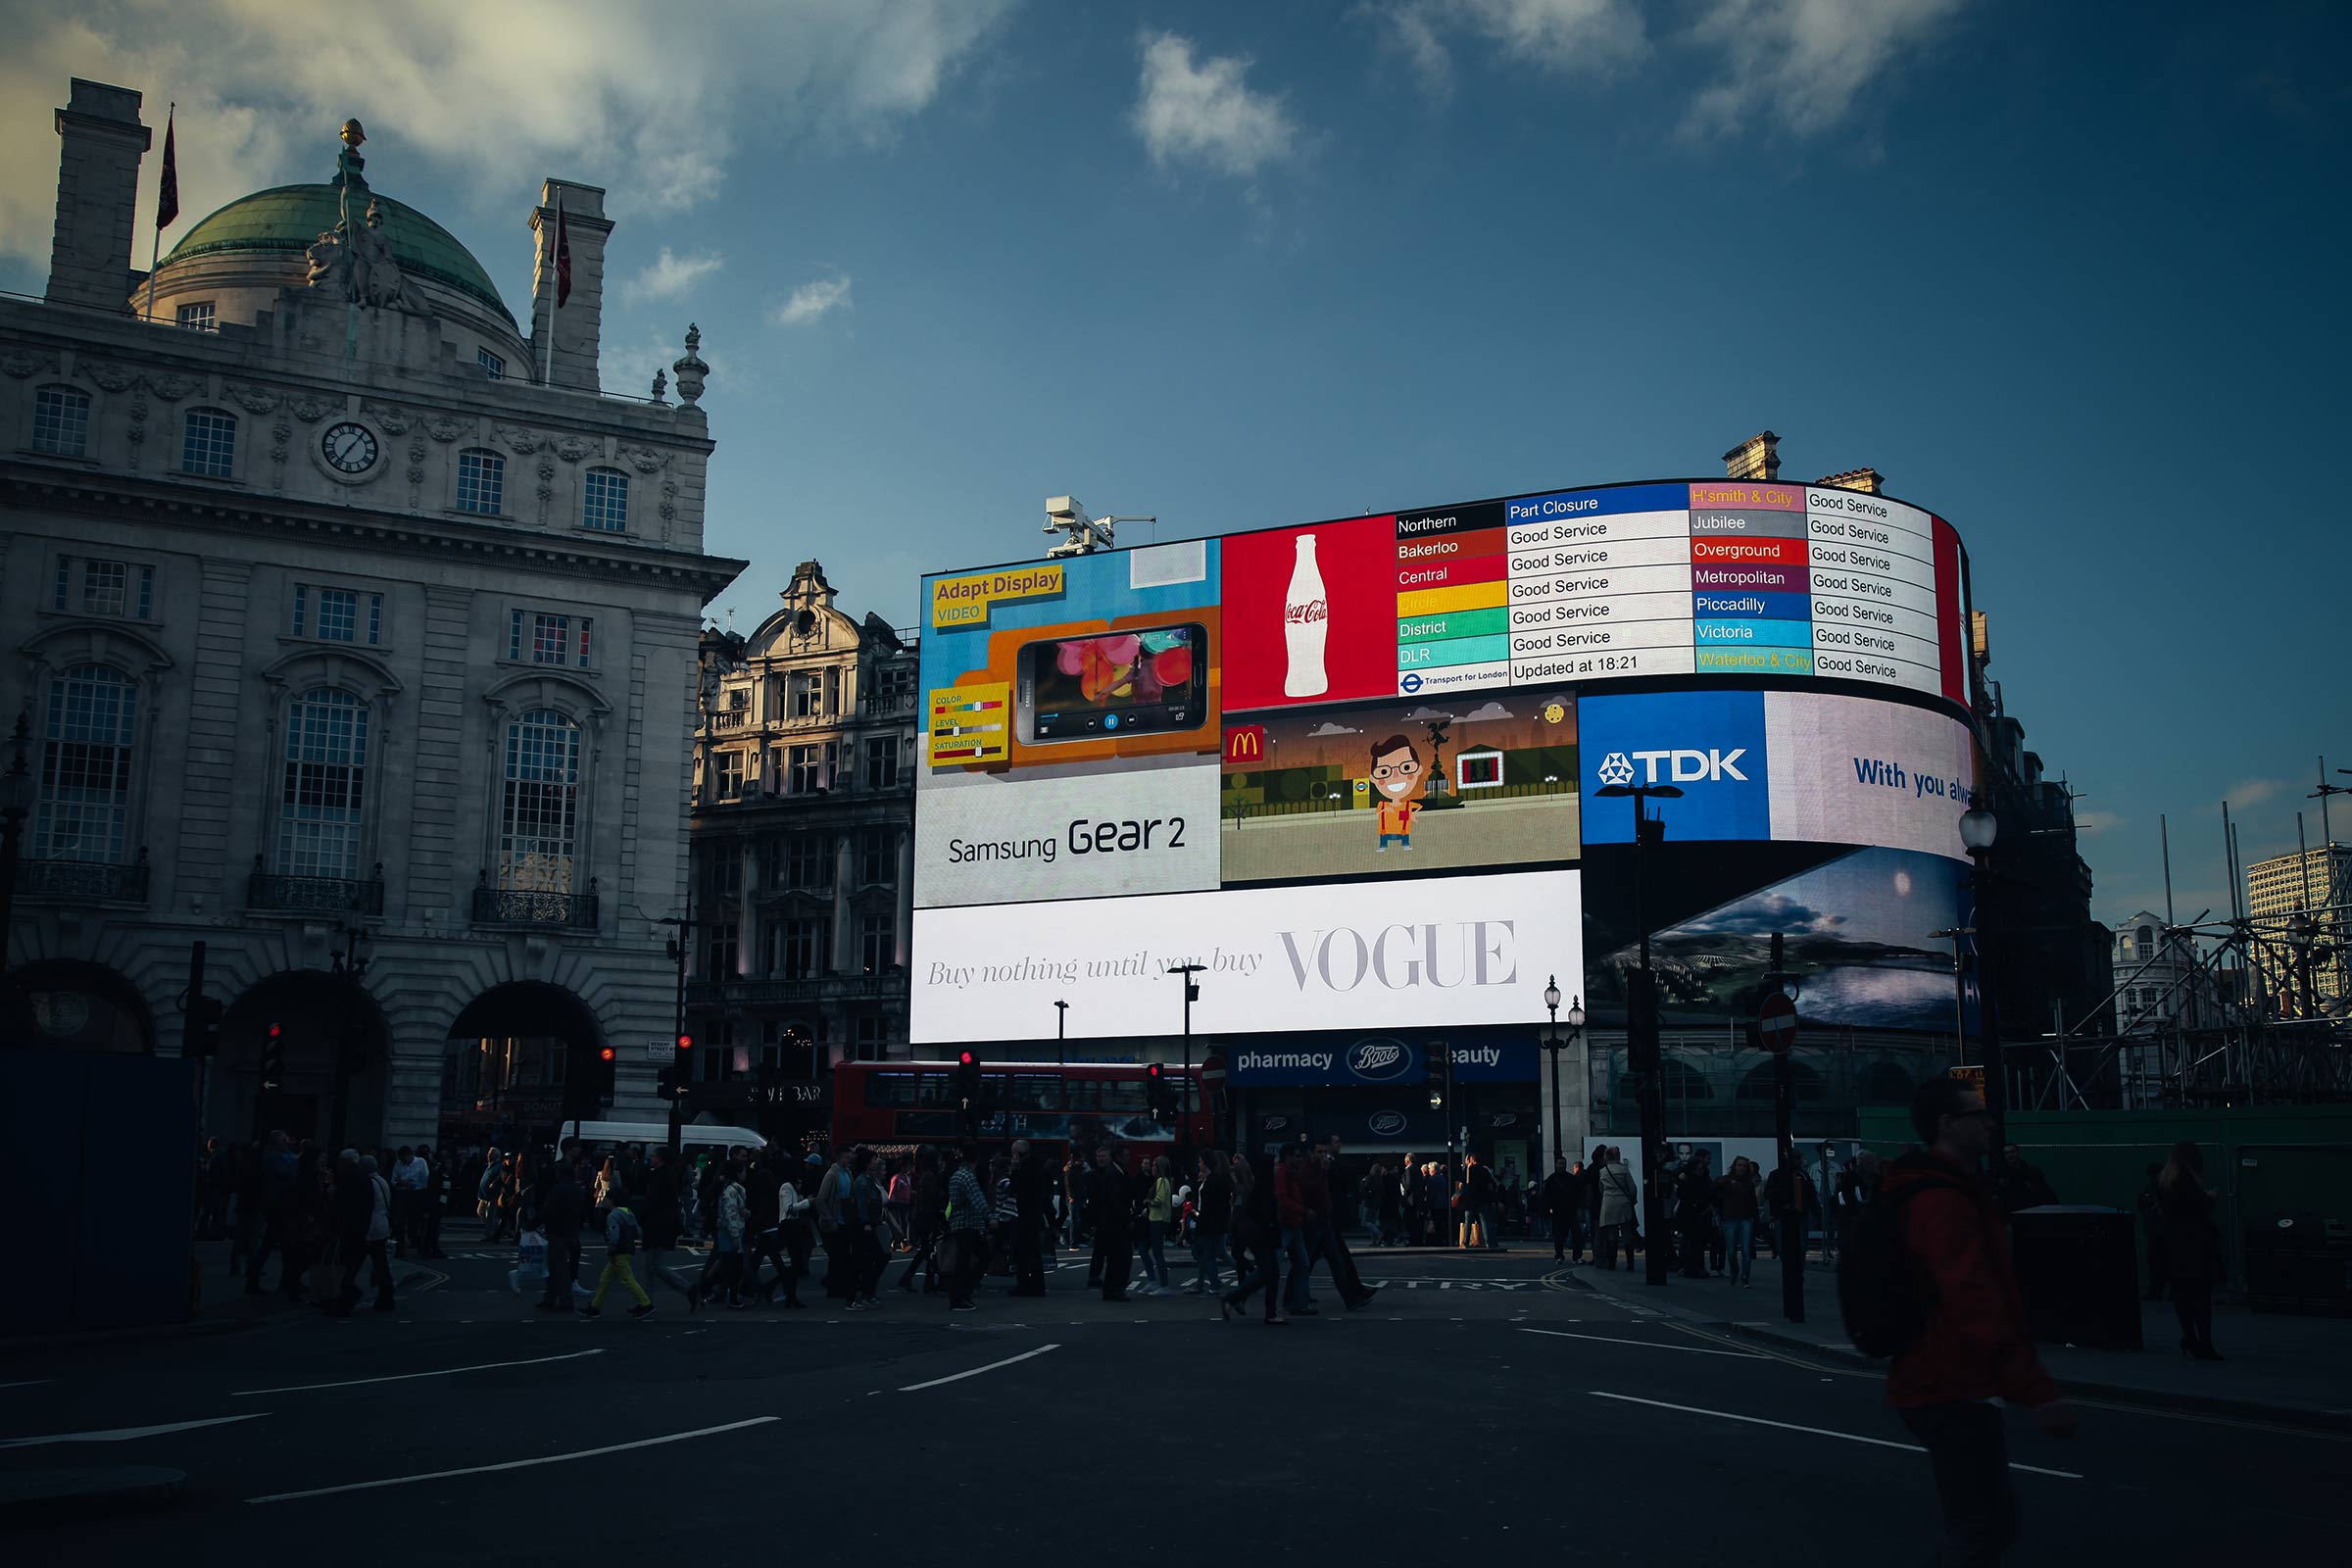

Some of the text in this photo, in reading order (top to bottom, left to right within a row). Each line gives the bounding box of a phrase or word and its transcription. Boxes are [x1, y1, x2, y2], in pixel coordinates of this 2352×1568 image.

[1692, 489, 1792, 507] H'smith & City
[1809, 493, 1887, 518] Good Service
[1510, 498, 1598, 519] Part Closure
[1398, 515, 1456, 533] Northern
[1693, 515, 1745, 529] Jubilee
[1811, 520, 1888, 544] Good Service
[1511, 523, 1607, 545] Good Service
[1398, 541, 1458, 559] Bakerloo
[1694, 543, 1781, 560] Overground
[1812, 547, 1890, 570] Good Service
[1512, 550, 1608, 571] Good Service
[937, 570, 1059, 601] Adapt Display
[1398, 567, 1447, 585] Central
[1695, 570, 1785, 586] Metropolitan
[1813, 573, 1891, 597] Good Service
[1512, 576, 1609, 598] Good Service
[937, 606, 980, 621] VIDEO
[1513, 604, 1610, 624] Good Service
[1696, 597, 1765, 614] Piccadilly
[1815, 601, 1893, 624] Good Service
[1400, 619, 1446, 637] District
[1697, 624, 1753, 639] Victoria
[1513, 631, 1610, 652] Good Service
[1816, 628, 1894, 652] Good Service
[1400, 649, 1430, 663] DLR
[1698, 653, 1812, 669] Waterloo & City
[1514, 656, 1638, 681] Updated at 18:21
[1817, 656, 1896, 678] Good Service
[1425, 669, 1507, 686] Transport for London
[936, 695, 961, 705] COLOR
[935, 718, 958, 727] LEVEL
[935, 739, 982, 751] SATURATION
[1632, 748, 1749, 783] TDK
[1853, 757, 1906, 789] With
[1914, 771, 1944, 799] you
[949, 816, 1186, 863] Samsung Gear 2
[928, 960, 975, 989] Buy
[982, 956, 1078, 985] nothing
[1087, 951, 1148, 978] until
[1213, 947, 1263, 976] buy
[1276, 919, 1517, 993] VOGUE
[1238, 1043, 1501, 1072] pharmacy Boots eauty
[1374, 1114, 1399, 1129] Boots
